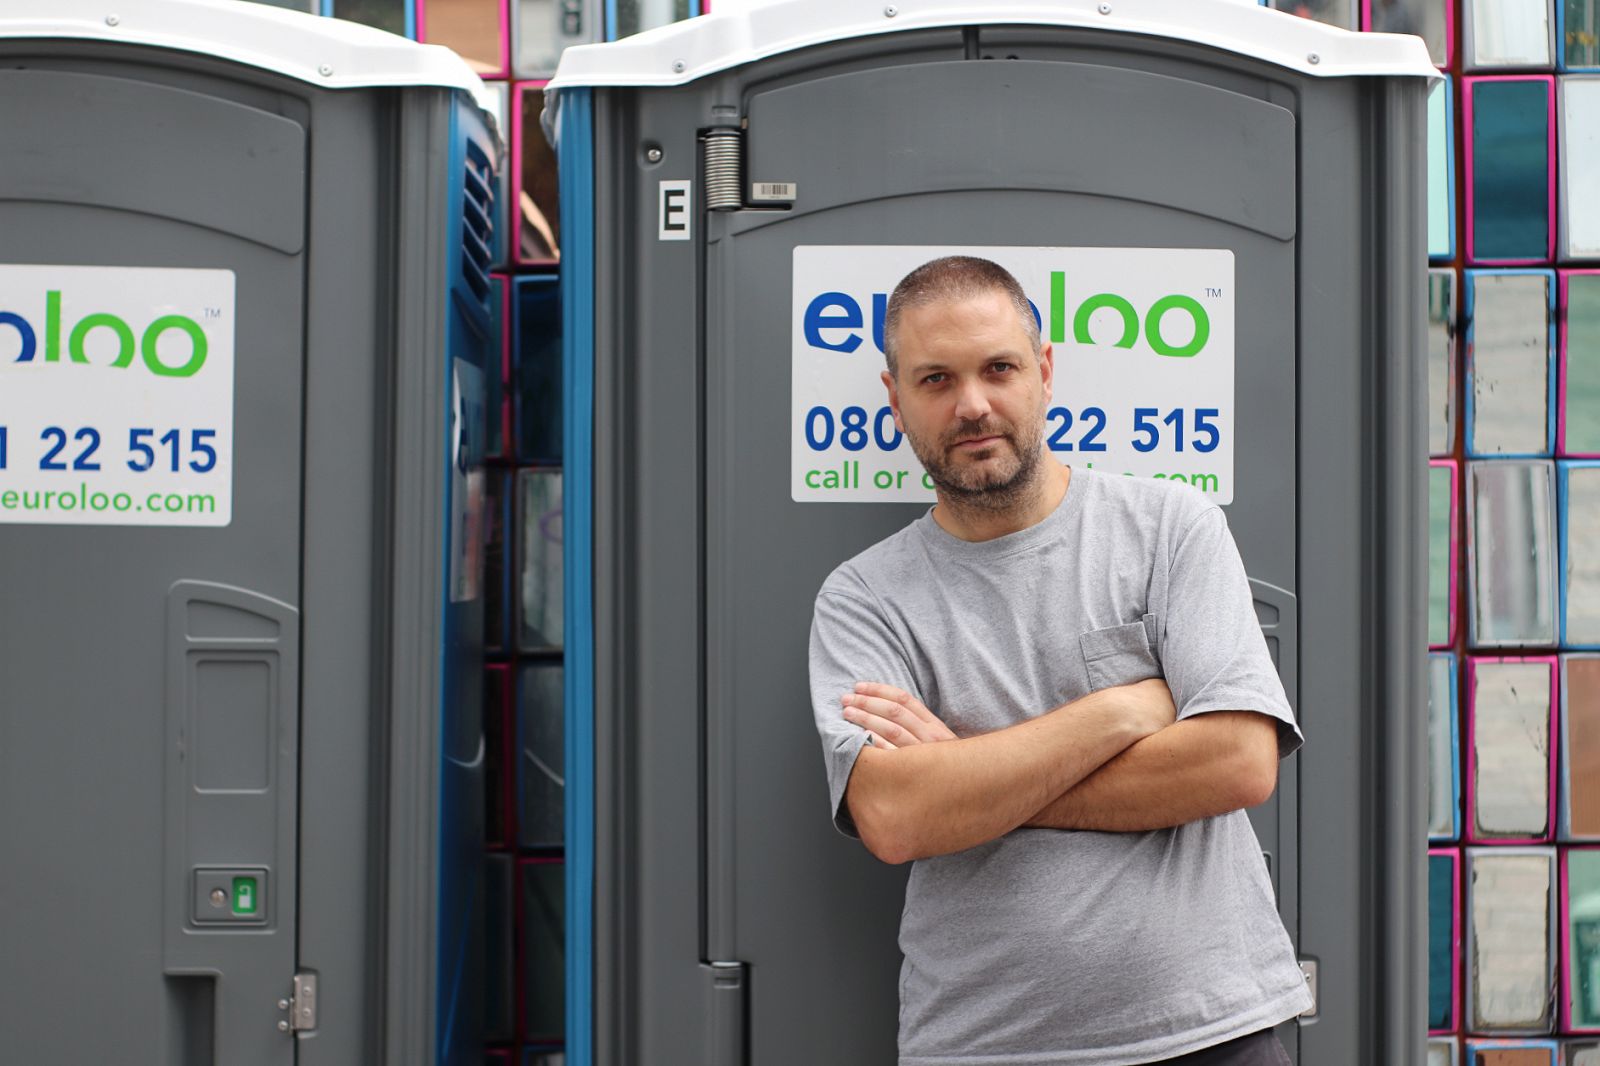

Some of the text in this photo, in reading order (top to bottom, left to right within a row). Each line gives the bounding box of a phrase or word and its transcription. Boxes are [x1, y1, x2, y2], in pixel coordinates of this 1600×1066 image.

[663, 189, 686, 231] E
[804, 271, 1210, 358] eloo
[39, 426, 102, 472] 22
[127, 428, 217, 474] 515
[1046, 406, 1108, 453] 22
[1131, 407, 1221, 454] 515
[804, 460, 859, 489] call
[873, 470, 908, 489] or
[1, 483, 216, 513] euroloo.com
